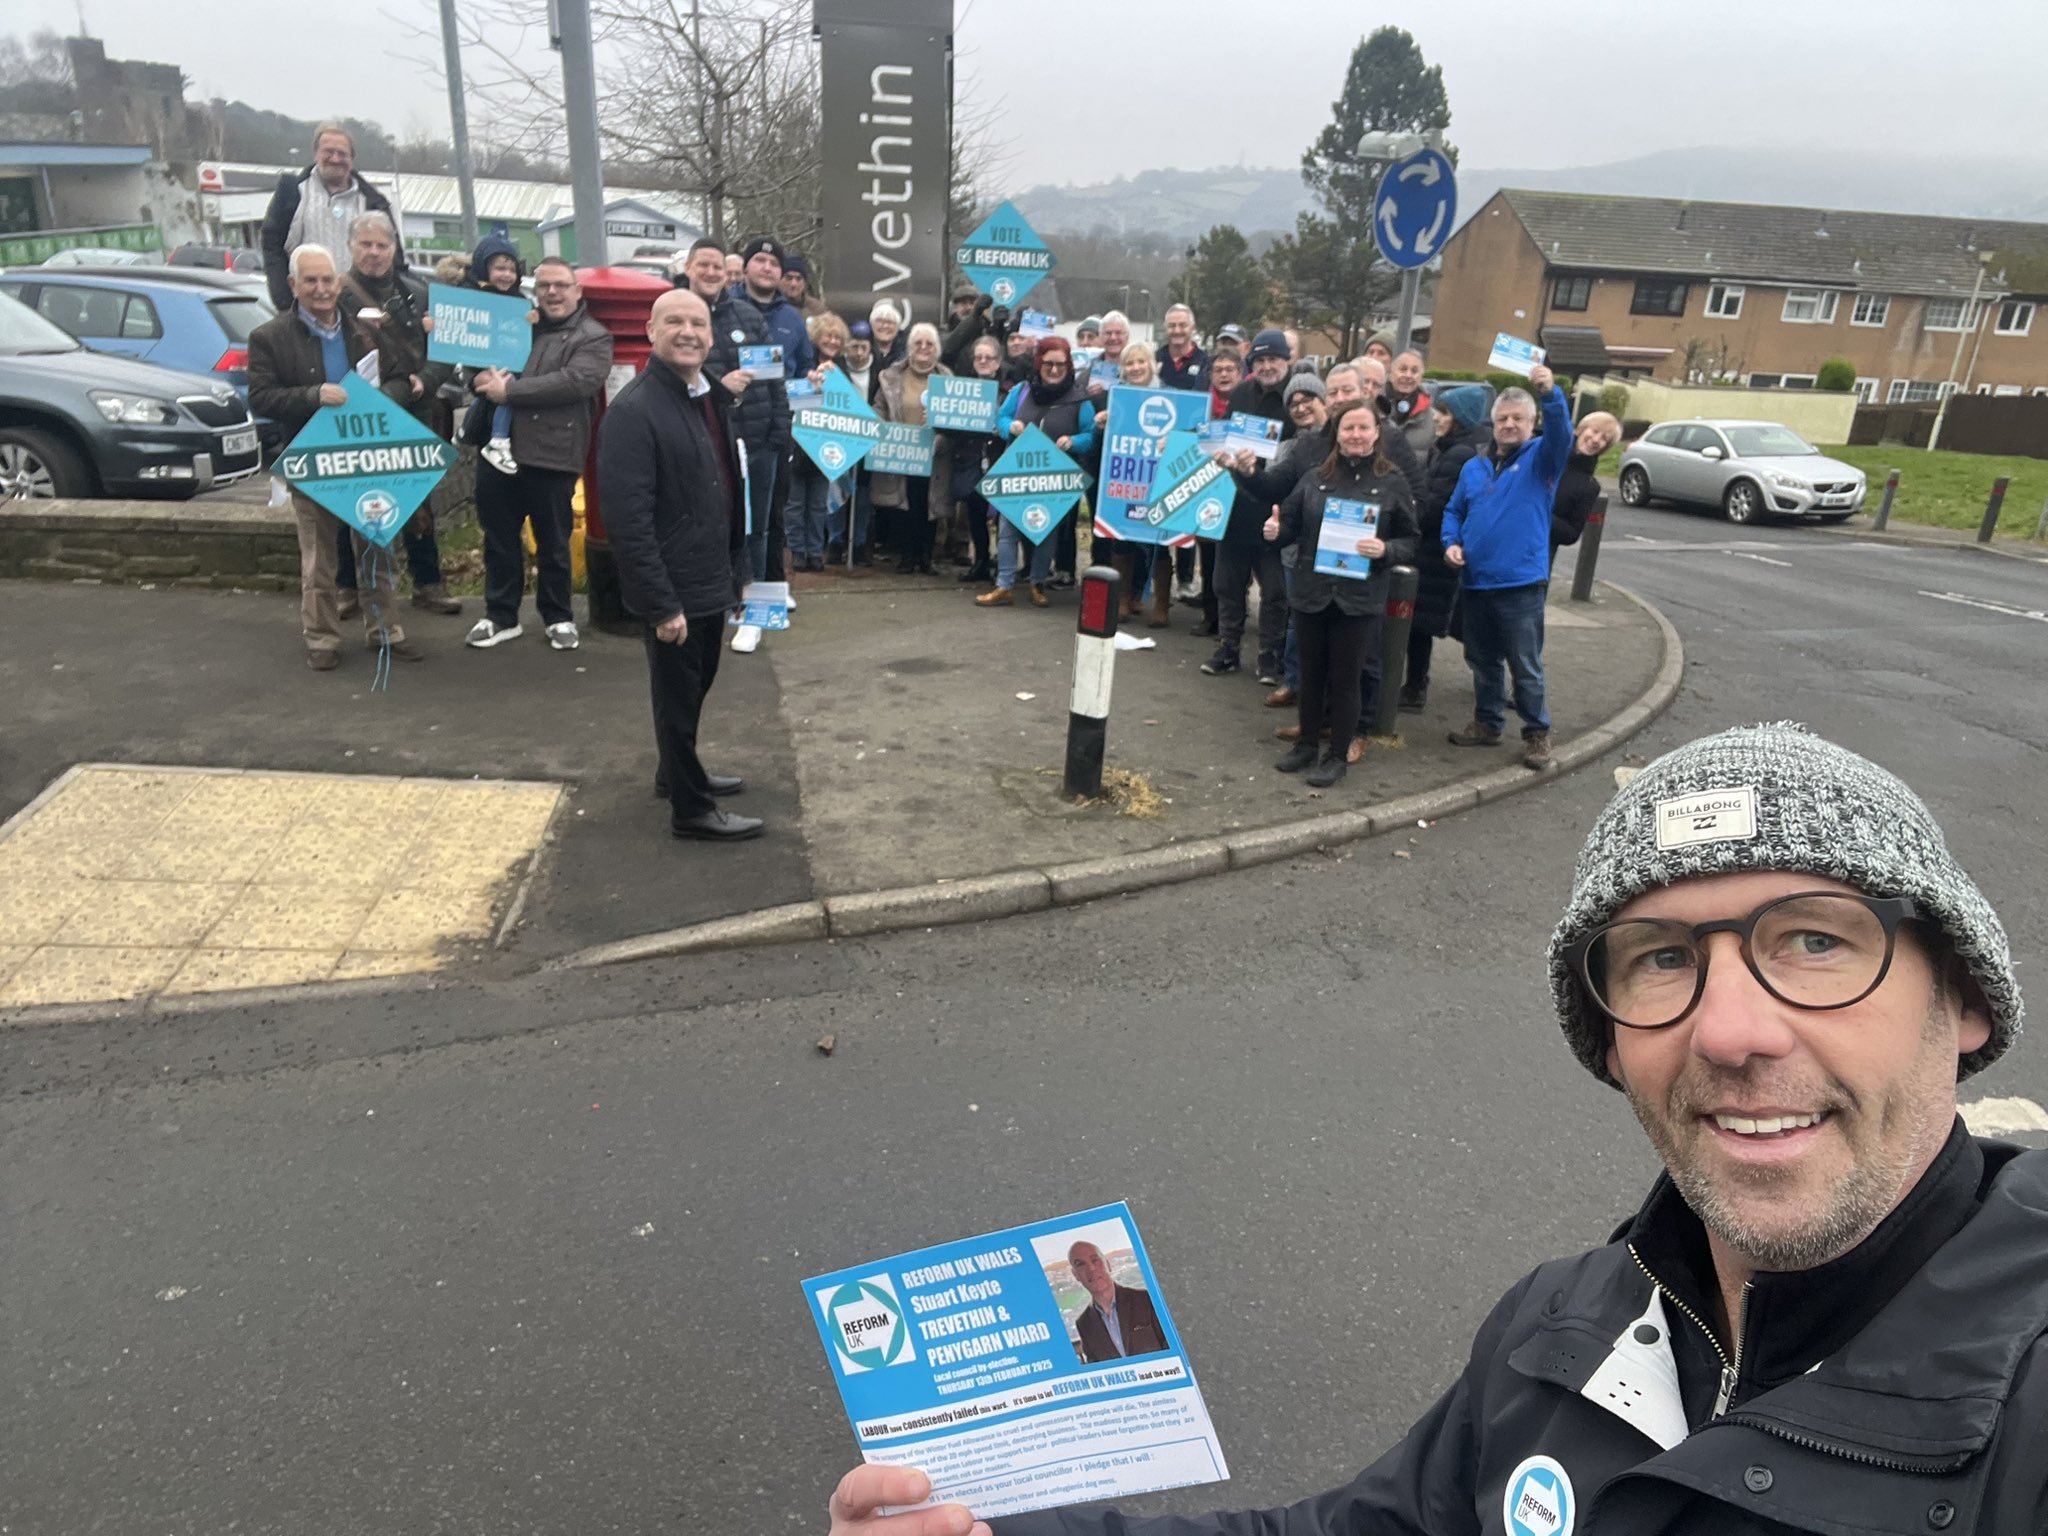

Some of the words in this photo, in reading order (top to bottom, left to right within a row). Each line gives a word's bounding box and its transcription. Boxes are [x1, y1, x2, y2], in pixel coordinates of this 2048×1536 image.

[857, 64, 913, 331] evethin
[991, 227, 1022, 243] VOTE
[435, 303, 490, 325] BRITAIN
[434, 329, 489, 350] REFORM
[826, 391, 851, 409] OTE
[944, 379, 982, 398] VOTE
[930, 396, 993, 417] REFORM
[333, 412, 390, 438] VOTE
[1111, 434, 1153, 457] LET'S
[1016, 450, 1051, 469] VOTE
[1110, 455, 1157, 484] BRIT
[1167, 444, 1201, 478] VOTE
[1108, 482, 1147, 499] GREAT
[1668, 800, 1741, 818] BILLABONG
[902, 1262, 955, 1288] REFORM
[954, 1257, 976, 1275] UK
[974, 1247, 1022, 1270] WALES
[911, 1289, 958, 1313] Stuart
[957, 1280, 1001, 1302] Keyte
[843, 1313, 889, 1334] REFORM
[919, 1307, 996, 1339] TREVETHIN
[997, 1305, 1010, 1321] &
[847, 1333, 864, 1348] UK
[927, 1333, 1002, 1366] PENYGARN
[1002, 1323, 1049, 1347] WARD
[933, 1371, 952, 1382] Local
[952, 1365, 977, 1378] council
[937, 1378, 974, 1394] THURSDAY
[975, 1375, 993, 1386] 13th
[993, 1365, 1030, 1381] FEBRUARY
[1031, 1359, 1052, 1372] 2025
[1023, 1395, 1037, 1403] time
[1052, 1378, 1090, 1395] REFORM
[1090, 1376, 1105, 1388] UK
[1104, 1370, 1137, 1385] WALES
[1138, 1372, 1153, 1380] lead
[1152, 1370, 1163, 1378] the
[861, 1424, 889, 1437] LABOUR
[902, 1412, 953, 1430] consistently
[953, 1405, 979, 1419] failed
[925, 1444, 947, 1453] Winter
[963, 1433, 995, 1445] Allowance
[1003, 1426, 1020, 1436] cruel
[1021, 1422, 1033, 1431] and
[1034, 1415, 1074, 1428] unnecessary
[1075, 1411, 1088, 1419] and
[1088, 1408, 1110, 1418] people
[1111, 1405, 1124, 1413] will
[949, 1452, 957, 1460] 20
[958, 1449, 973, 1457] mph
[973, 1443, 993, 1454] speed
[1012, 1432, 1047, 1444] destroying
[1093, 1418, 1122, 1426] madness
[1123, 1415, 1138, 1424] goes
[1180, 1405, 1187, 1413] of
[943, 1463, 961, 1473] given
[961, 1458, 983, 1468] Labour
[997, 1448, 1022, 1459] support
[1036, 1442, 1047, 1450] our
[1050, 1435, 1076, 1447] political
[1076, 1432, 1101, 1440] leaders
[1118, 1424, 1149, 1434] forgotten
[1150, 1421, 1165, 1429] that
[933, 1474, 959, 1485] servants
[955, 1485, 983, 1497] elected
[994, 1480, 1012, 1491] your
[1013, 1474, 1033, 1485] local
[1034, 1467, 1072, 1480] councillor
[1084, 1460, 1110, 1472] pledge
[1111, 1457, 1129, 1466] that
[1135, 1452, 1150, 1462] will
[1018, 1492, 1034, 1500] litter
[1036, 1489, 1048, 1497] and
[1085, 1480, 1098, 1488] dog
[1517, 1505, 1530, 1522] UK
[1522, 1493, 1556, 1526] REFORM
